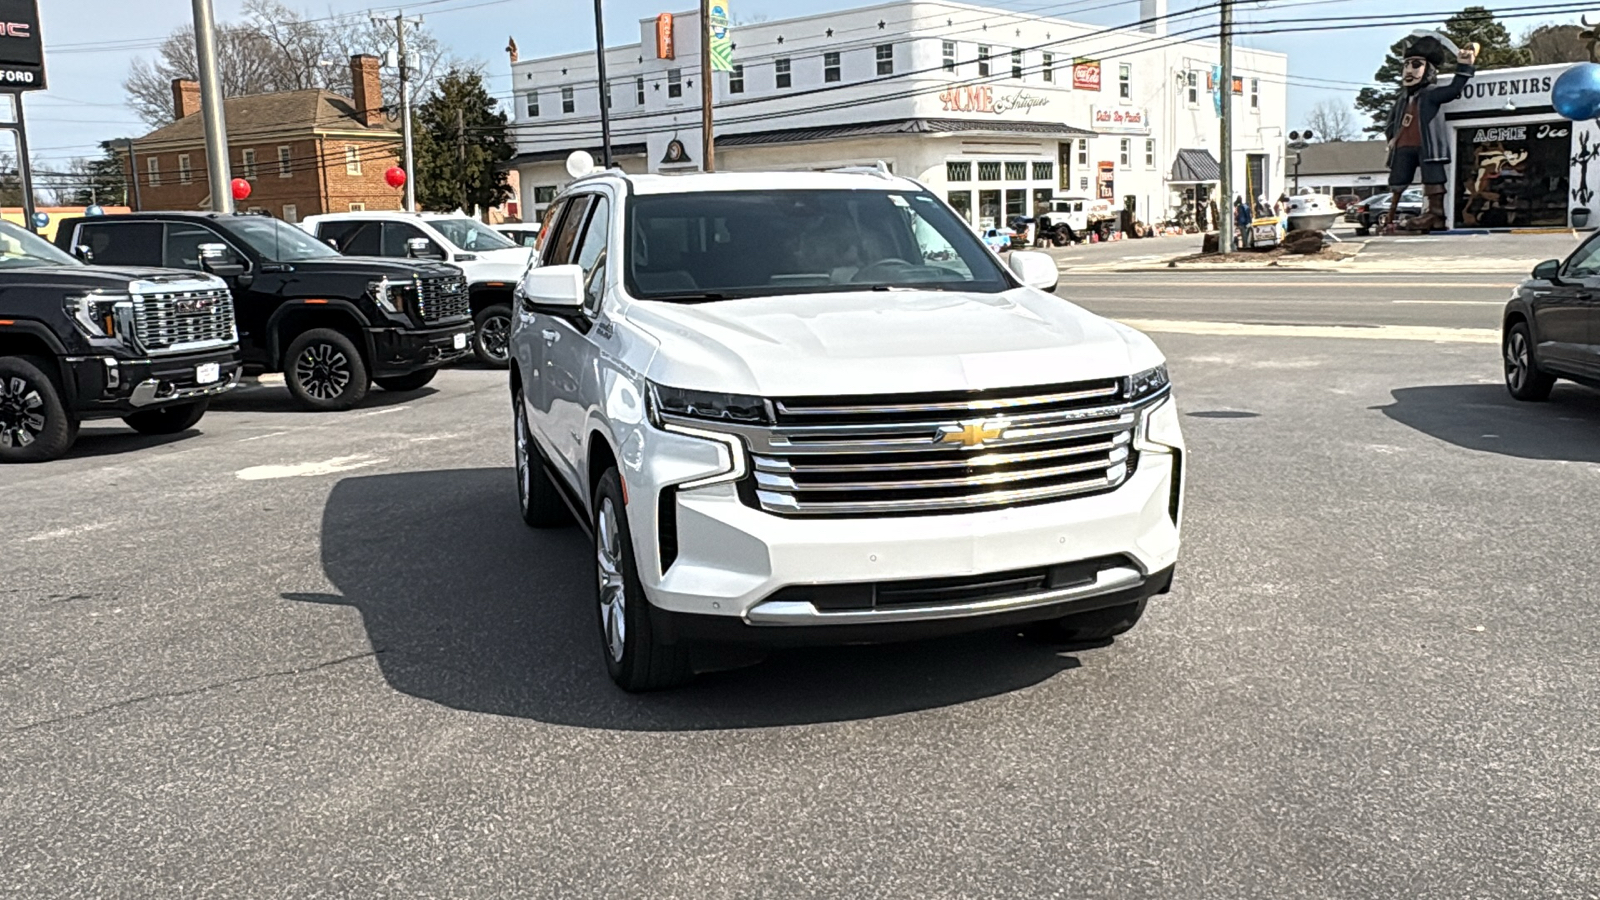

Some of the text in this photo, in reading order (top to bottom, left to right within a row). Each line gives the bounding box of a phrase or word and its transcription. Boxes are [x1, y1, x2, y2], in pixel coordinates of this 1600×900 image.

[0, 22, 30, 37] C
[1456, 76, 1552, 100] OUVENIRS
[939, 85, 994, 113] ACME
[1473, 124, 1569, 142] ACME Ice
[1101, 186, 1113, 198] TEA
